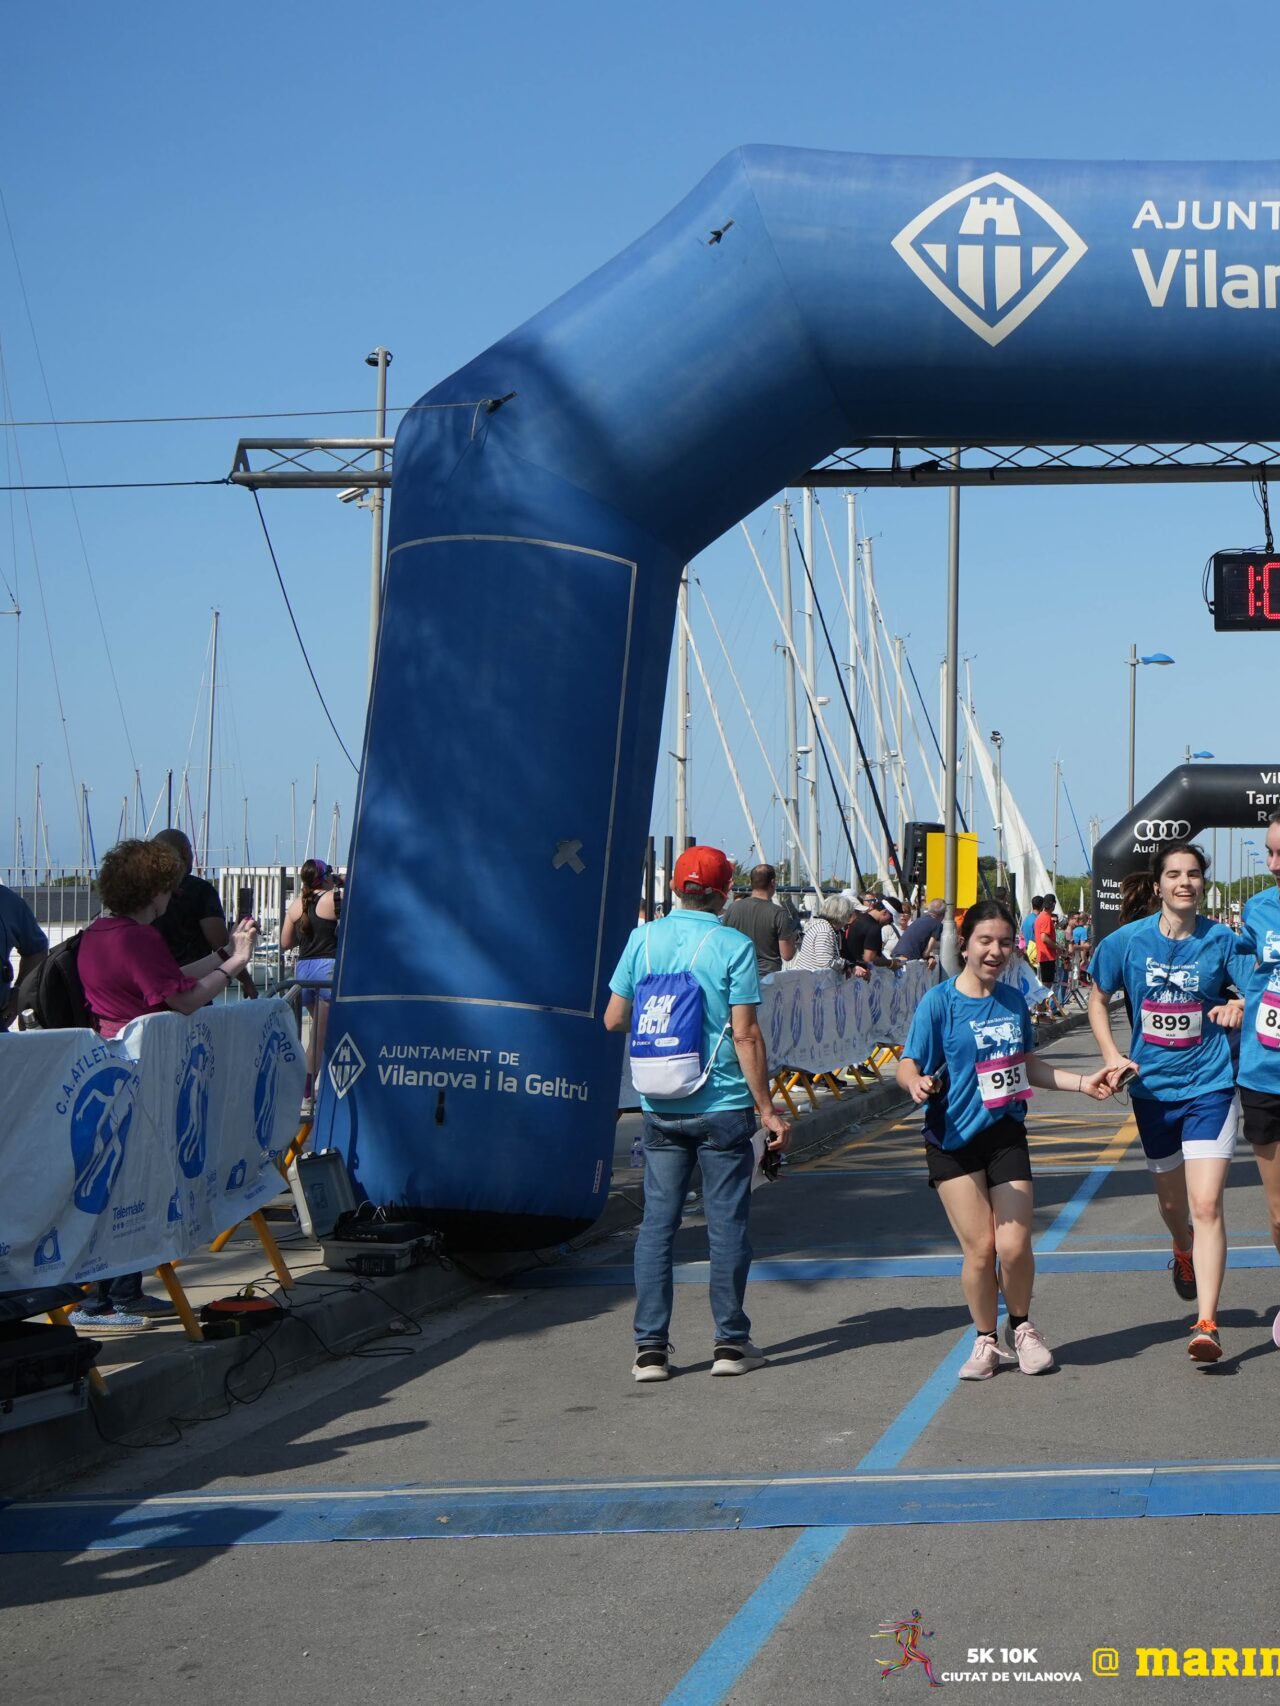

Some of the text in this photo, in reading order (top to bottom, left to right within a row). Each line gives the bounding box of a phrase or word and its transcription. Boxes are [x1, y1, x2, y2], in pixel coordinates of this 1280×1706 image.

[1132, 843, 1160, 853] Audi
[643, 994, 677, 1014] 42K
[637, 1013, 671, 1035] BCN
[1152, 1014, 1191, 1031] 899
[378, 1045, 520, 1066] AJUNTAMENT DE
[378, 1064, 589, 1102] Vilanova i la Geltrú
[991, 1067, 1021, 1090] 935
